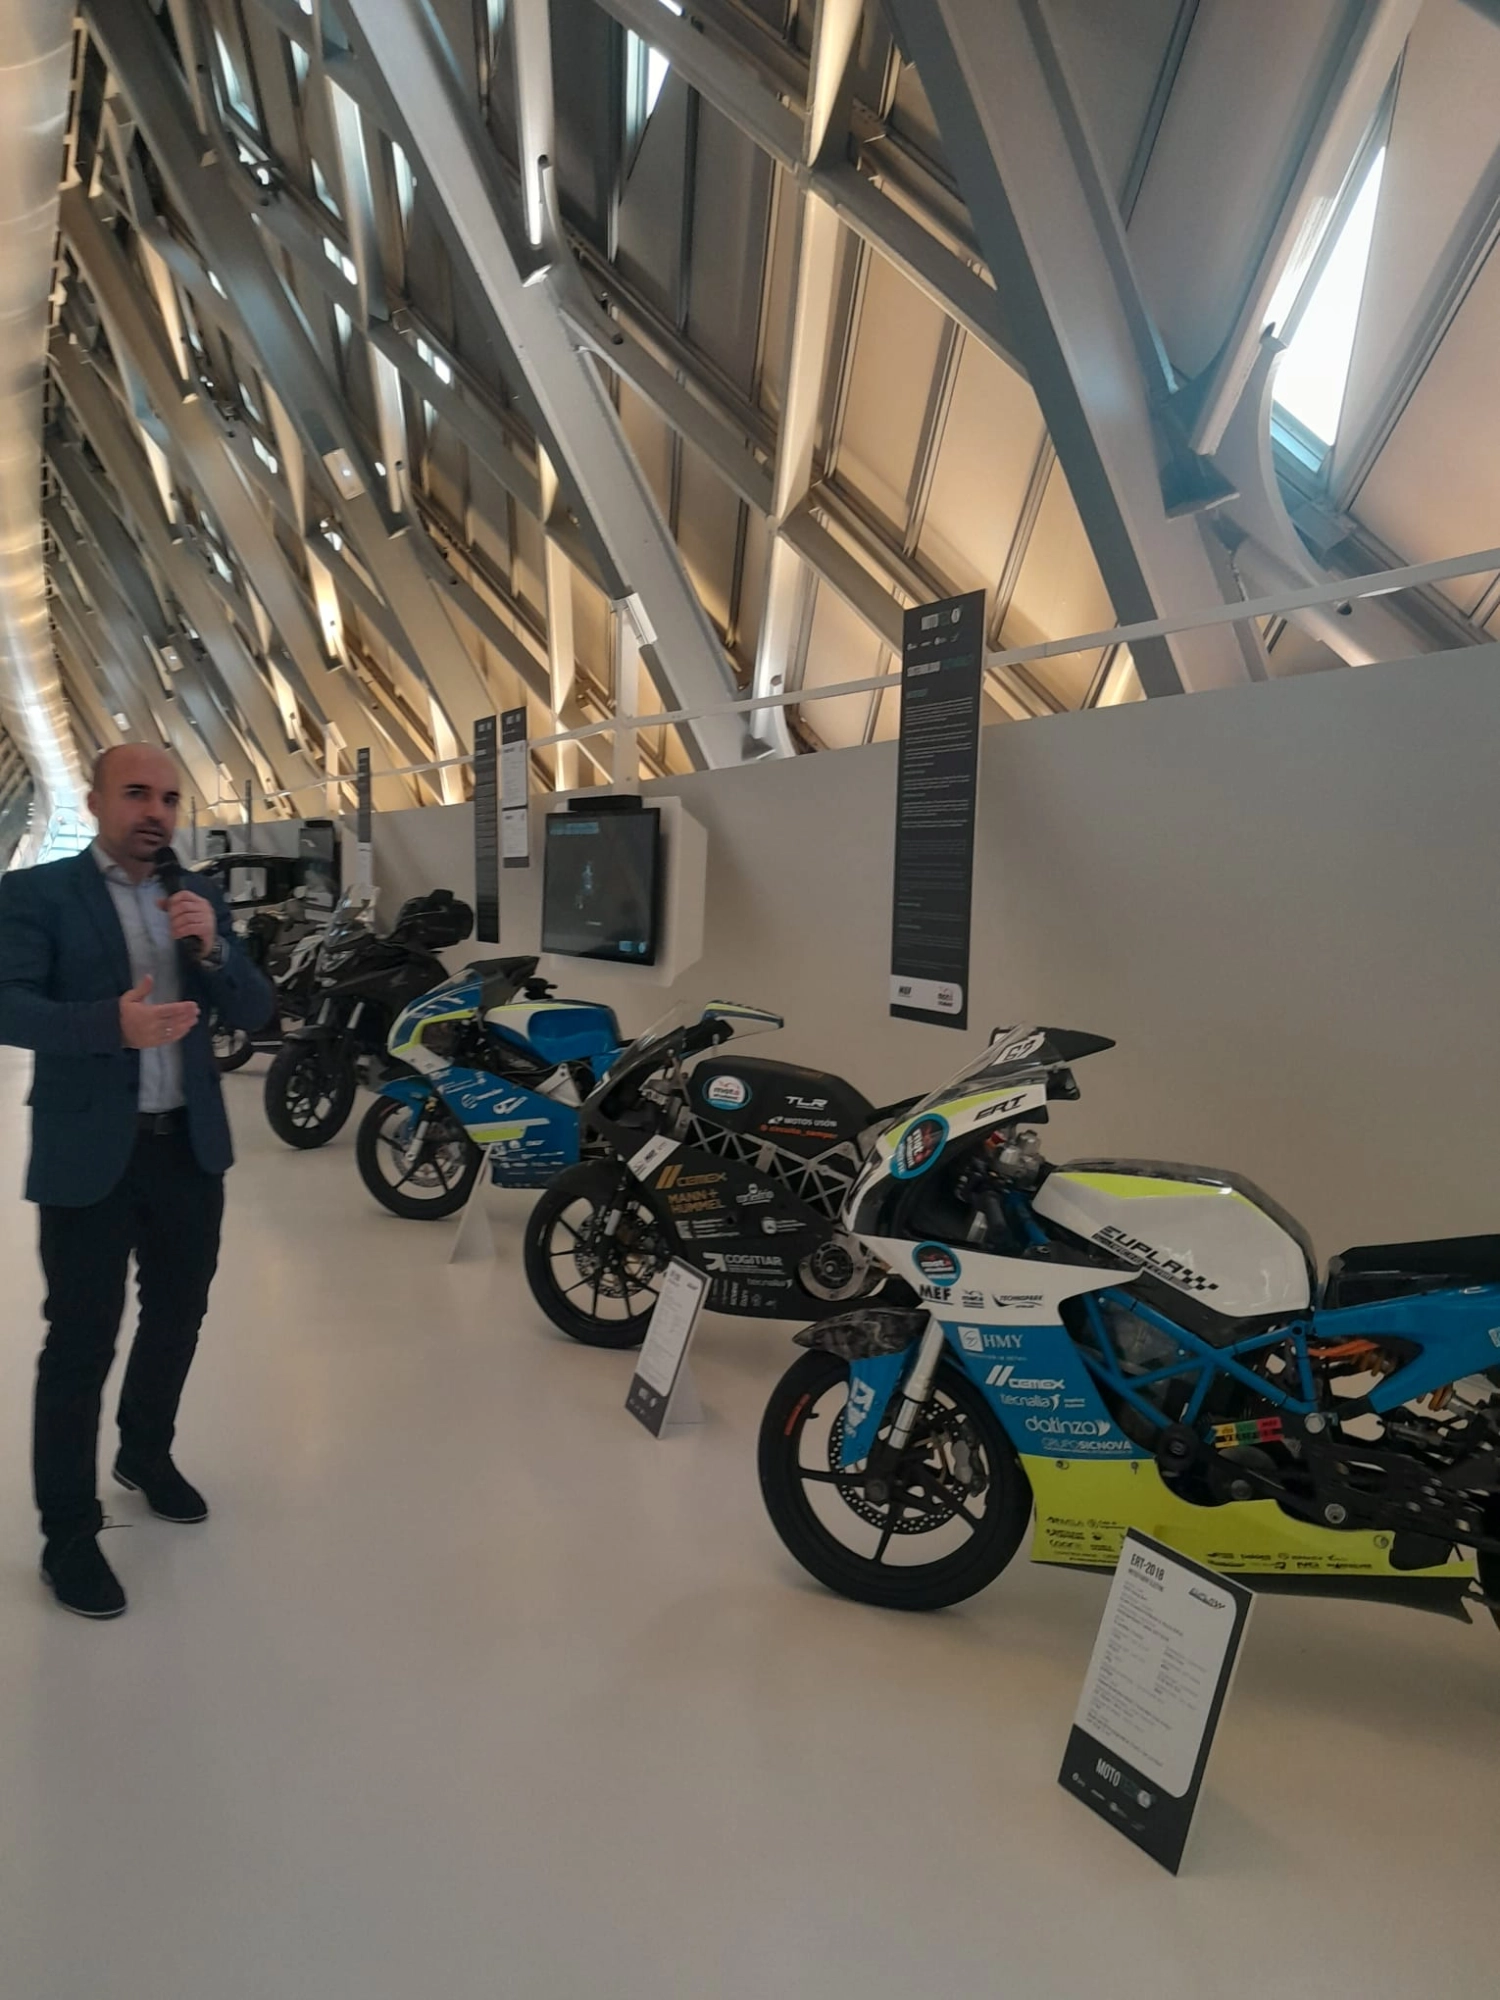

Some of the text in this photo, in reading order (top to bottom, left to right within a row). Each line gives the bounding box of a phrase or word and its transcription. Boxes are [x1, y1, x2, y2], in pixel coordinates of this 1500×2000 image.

[785, 1095, 829, 1108] TLR
[973, 1093, 1028, 1122] ERT
[1099, 1225, 1185, 1274] EUPLA
[919, 1284, 952, 1301] MEF
[982, 1333, 1024, 1348] HMY
[1129, 1552, 1166, 1582] ERT-2018
[1095, 1757, 1122, 1788] MOTO
